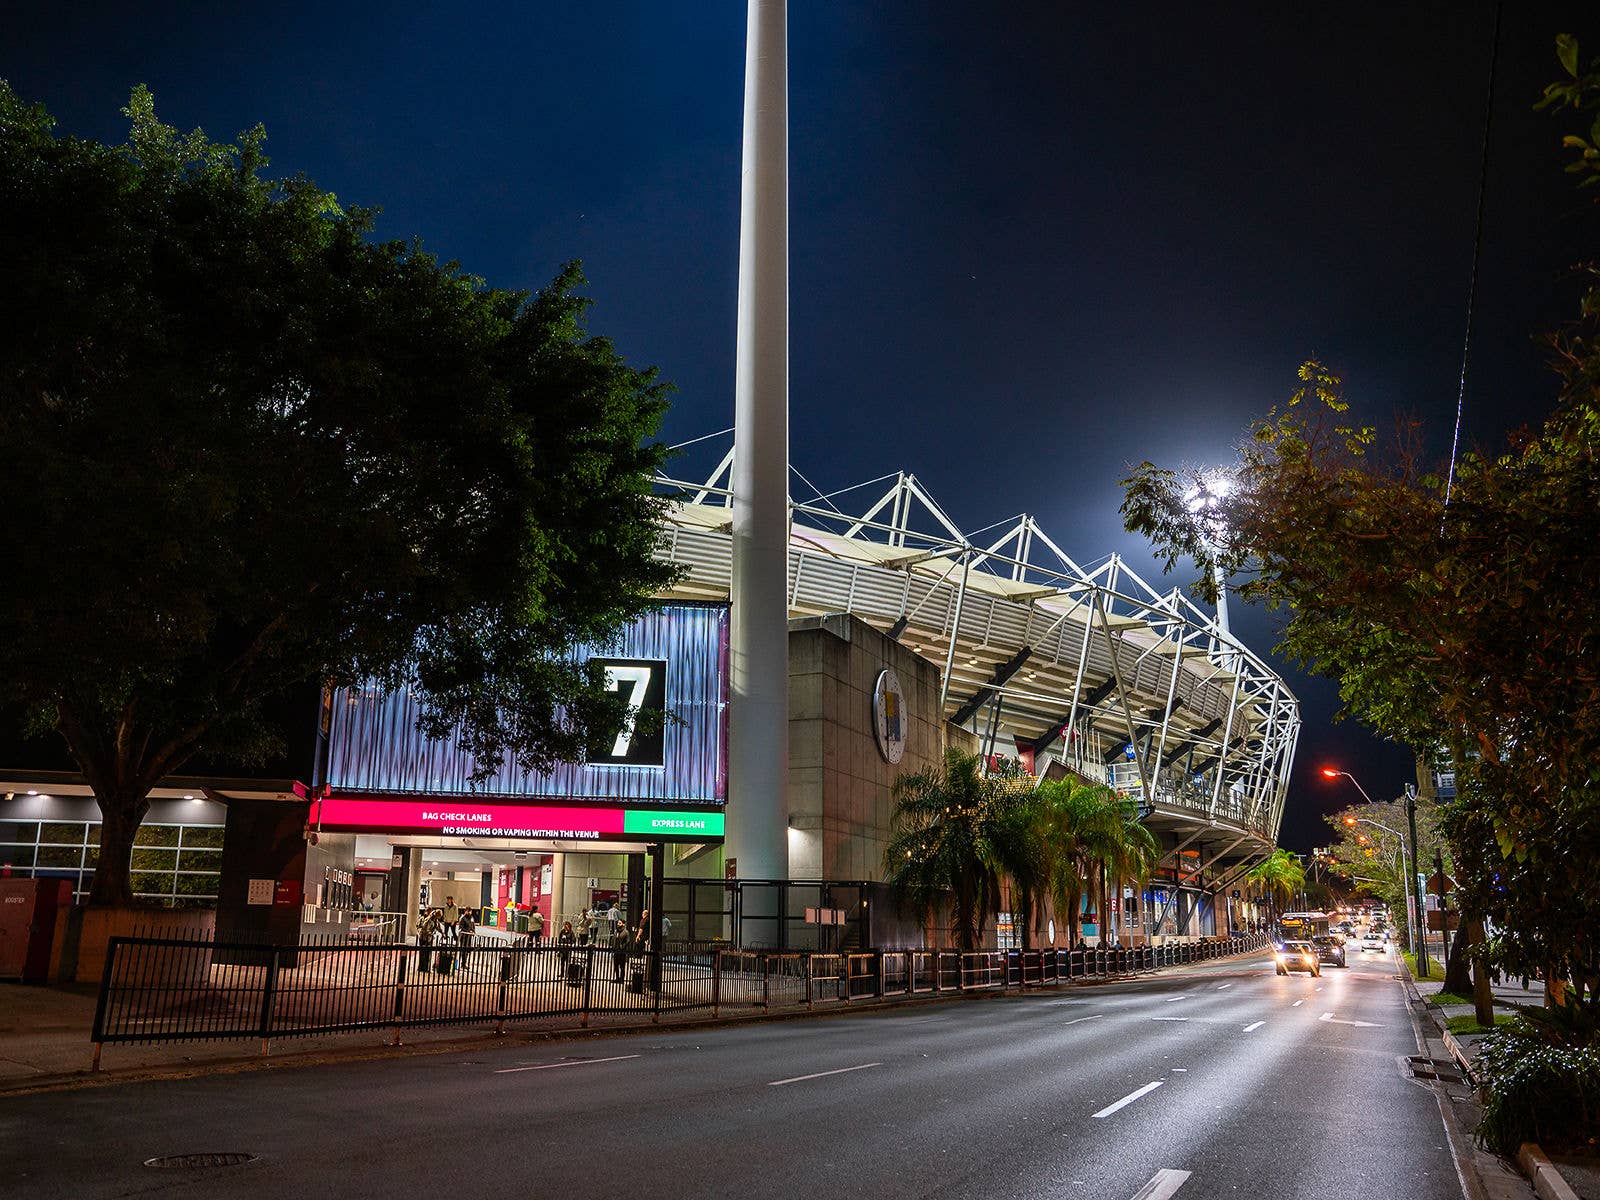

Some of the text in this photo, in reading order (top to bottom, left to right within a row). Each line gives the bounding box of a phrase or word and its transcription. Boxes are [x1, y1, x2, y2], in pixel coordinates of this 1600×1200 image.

[604, 666, 651, 757] 7
[422, 812, 492, 822] BAG CHECK LANES
[651, 819, 705, 829] EXPRESS LANE
[442, 826, 600, 839] NO SMOKING OR VAPING WITHIN THE VENUE
